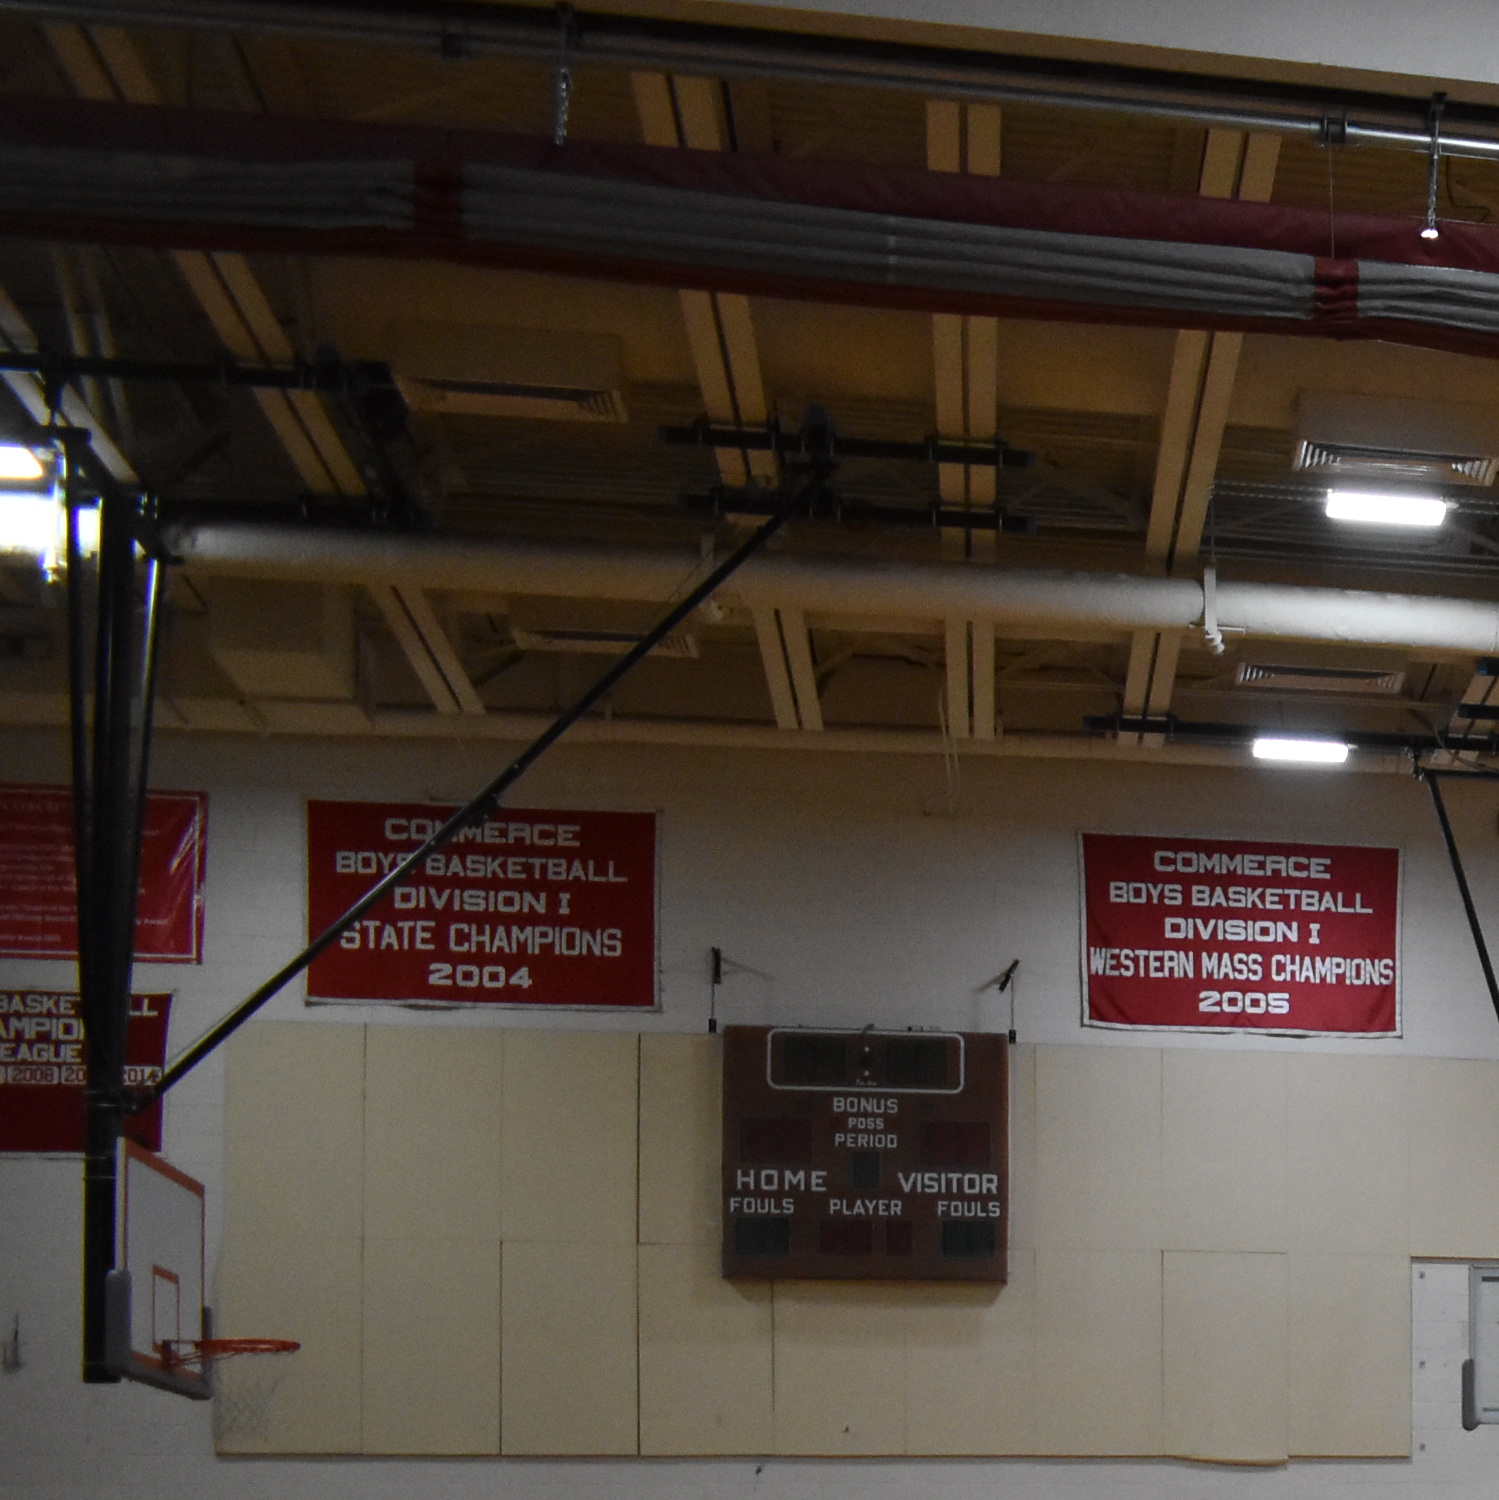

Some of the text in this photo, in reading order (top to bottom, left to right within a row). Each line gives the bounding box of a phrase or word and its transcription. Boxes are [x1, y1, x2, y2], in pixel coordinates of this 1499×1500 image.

[425, 854, 628, 883] BASKETBALL
[1154, 850, 1331, 879] COMMERCE
[394, 886, 571, 915] DIVISION I
[1109, 881, 1373, 914] BOYS BASKETBALL
[340, 920, 622, 957] STATE CHAMPIONS
[1165, 917, 1320, 944] DIVISION I
[428, 963, 533, 989] 2004
[1090, 946, 1394, 985] WESTERN MASS CHAMPIONS
[1199, 991, 1290, 1014] 2005
[833, 1097, 898, 1114] BONUS
[848, 1117, 884, 1129] POSS
[834, 1134, 898, 1148] PERIOD
[737, 1169, 999, 1195] HOME VISITOR
[730, 1197, 1000, 1217] FOULS PLAYER FOULS
